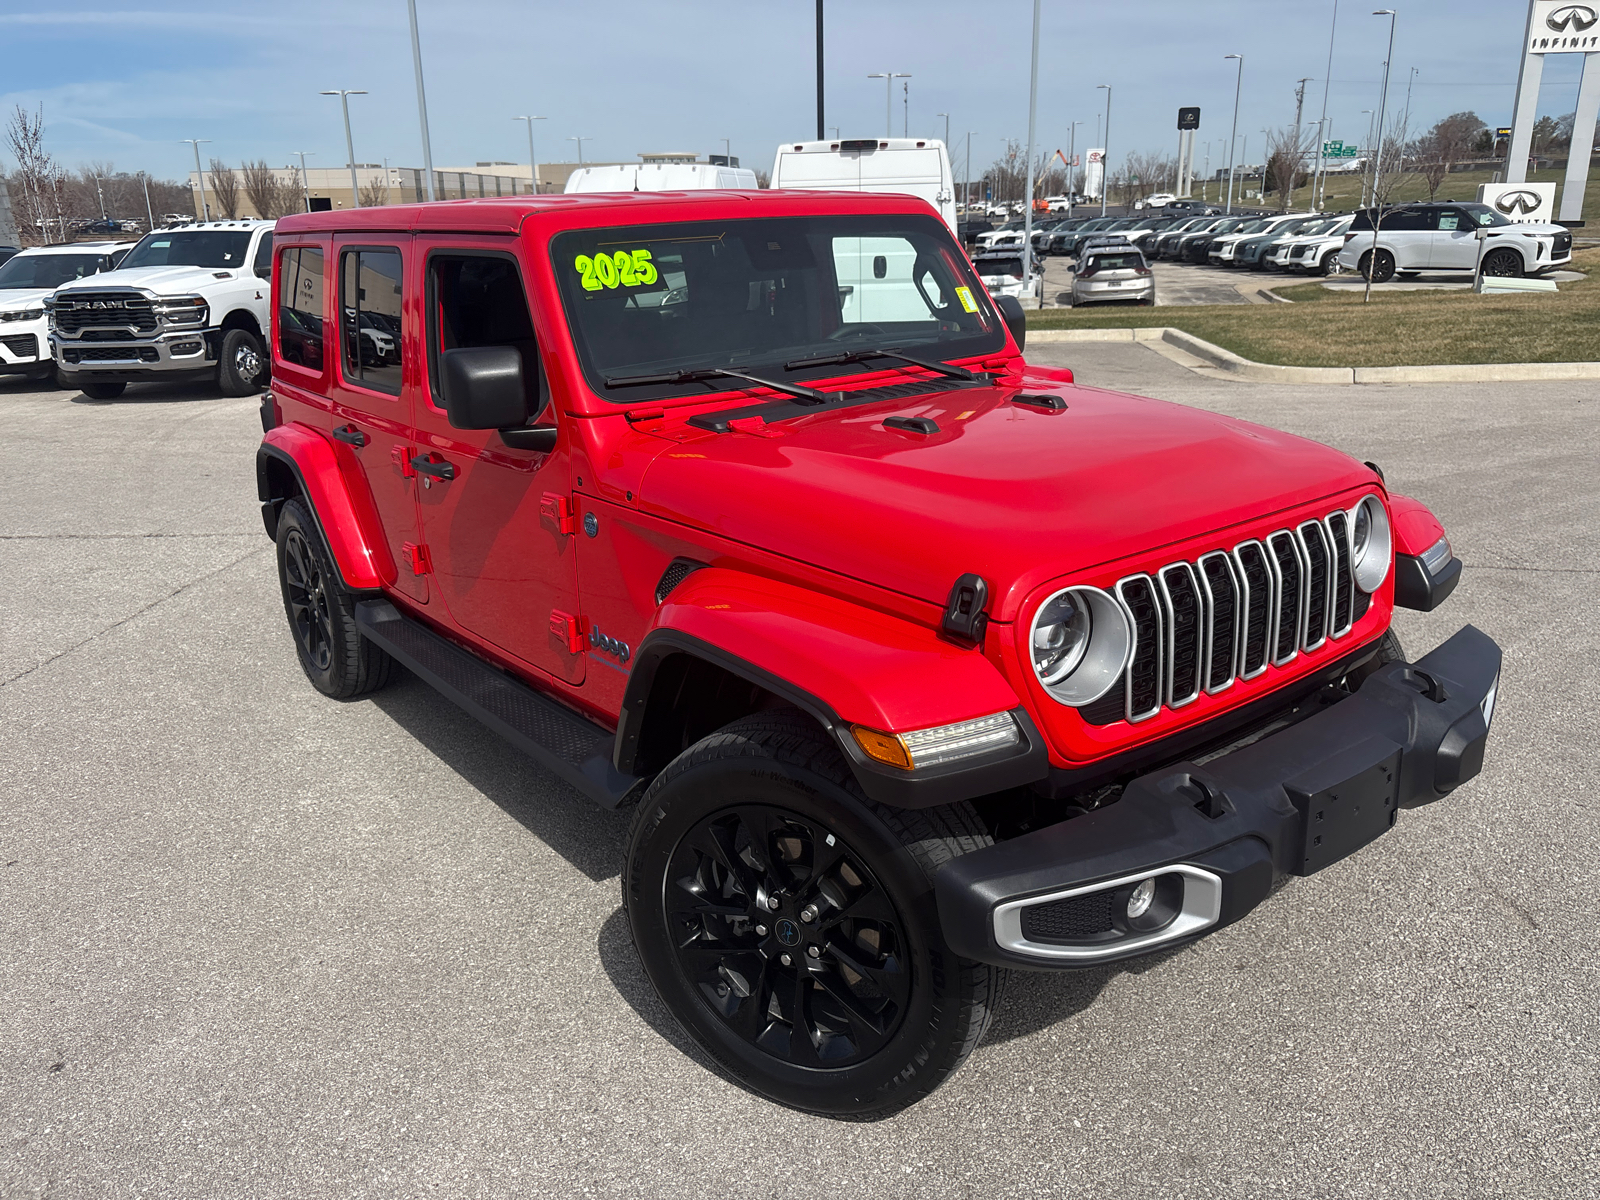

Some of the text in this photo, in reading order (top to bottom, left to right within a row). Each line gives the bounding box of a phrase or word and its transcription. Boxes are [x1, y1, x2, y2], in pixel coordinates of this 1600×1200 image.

[1532, 36, 1599, 49] INFINIT
[574, 249, 658, 292] 2025
[75, 301, 123, 309] RAM
[588, 624, 630, 664] Jeep
[750, 768, 819, 795] All-Weather
